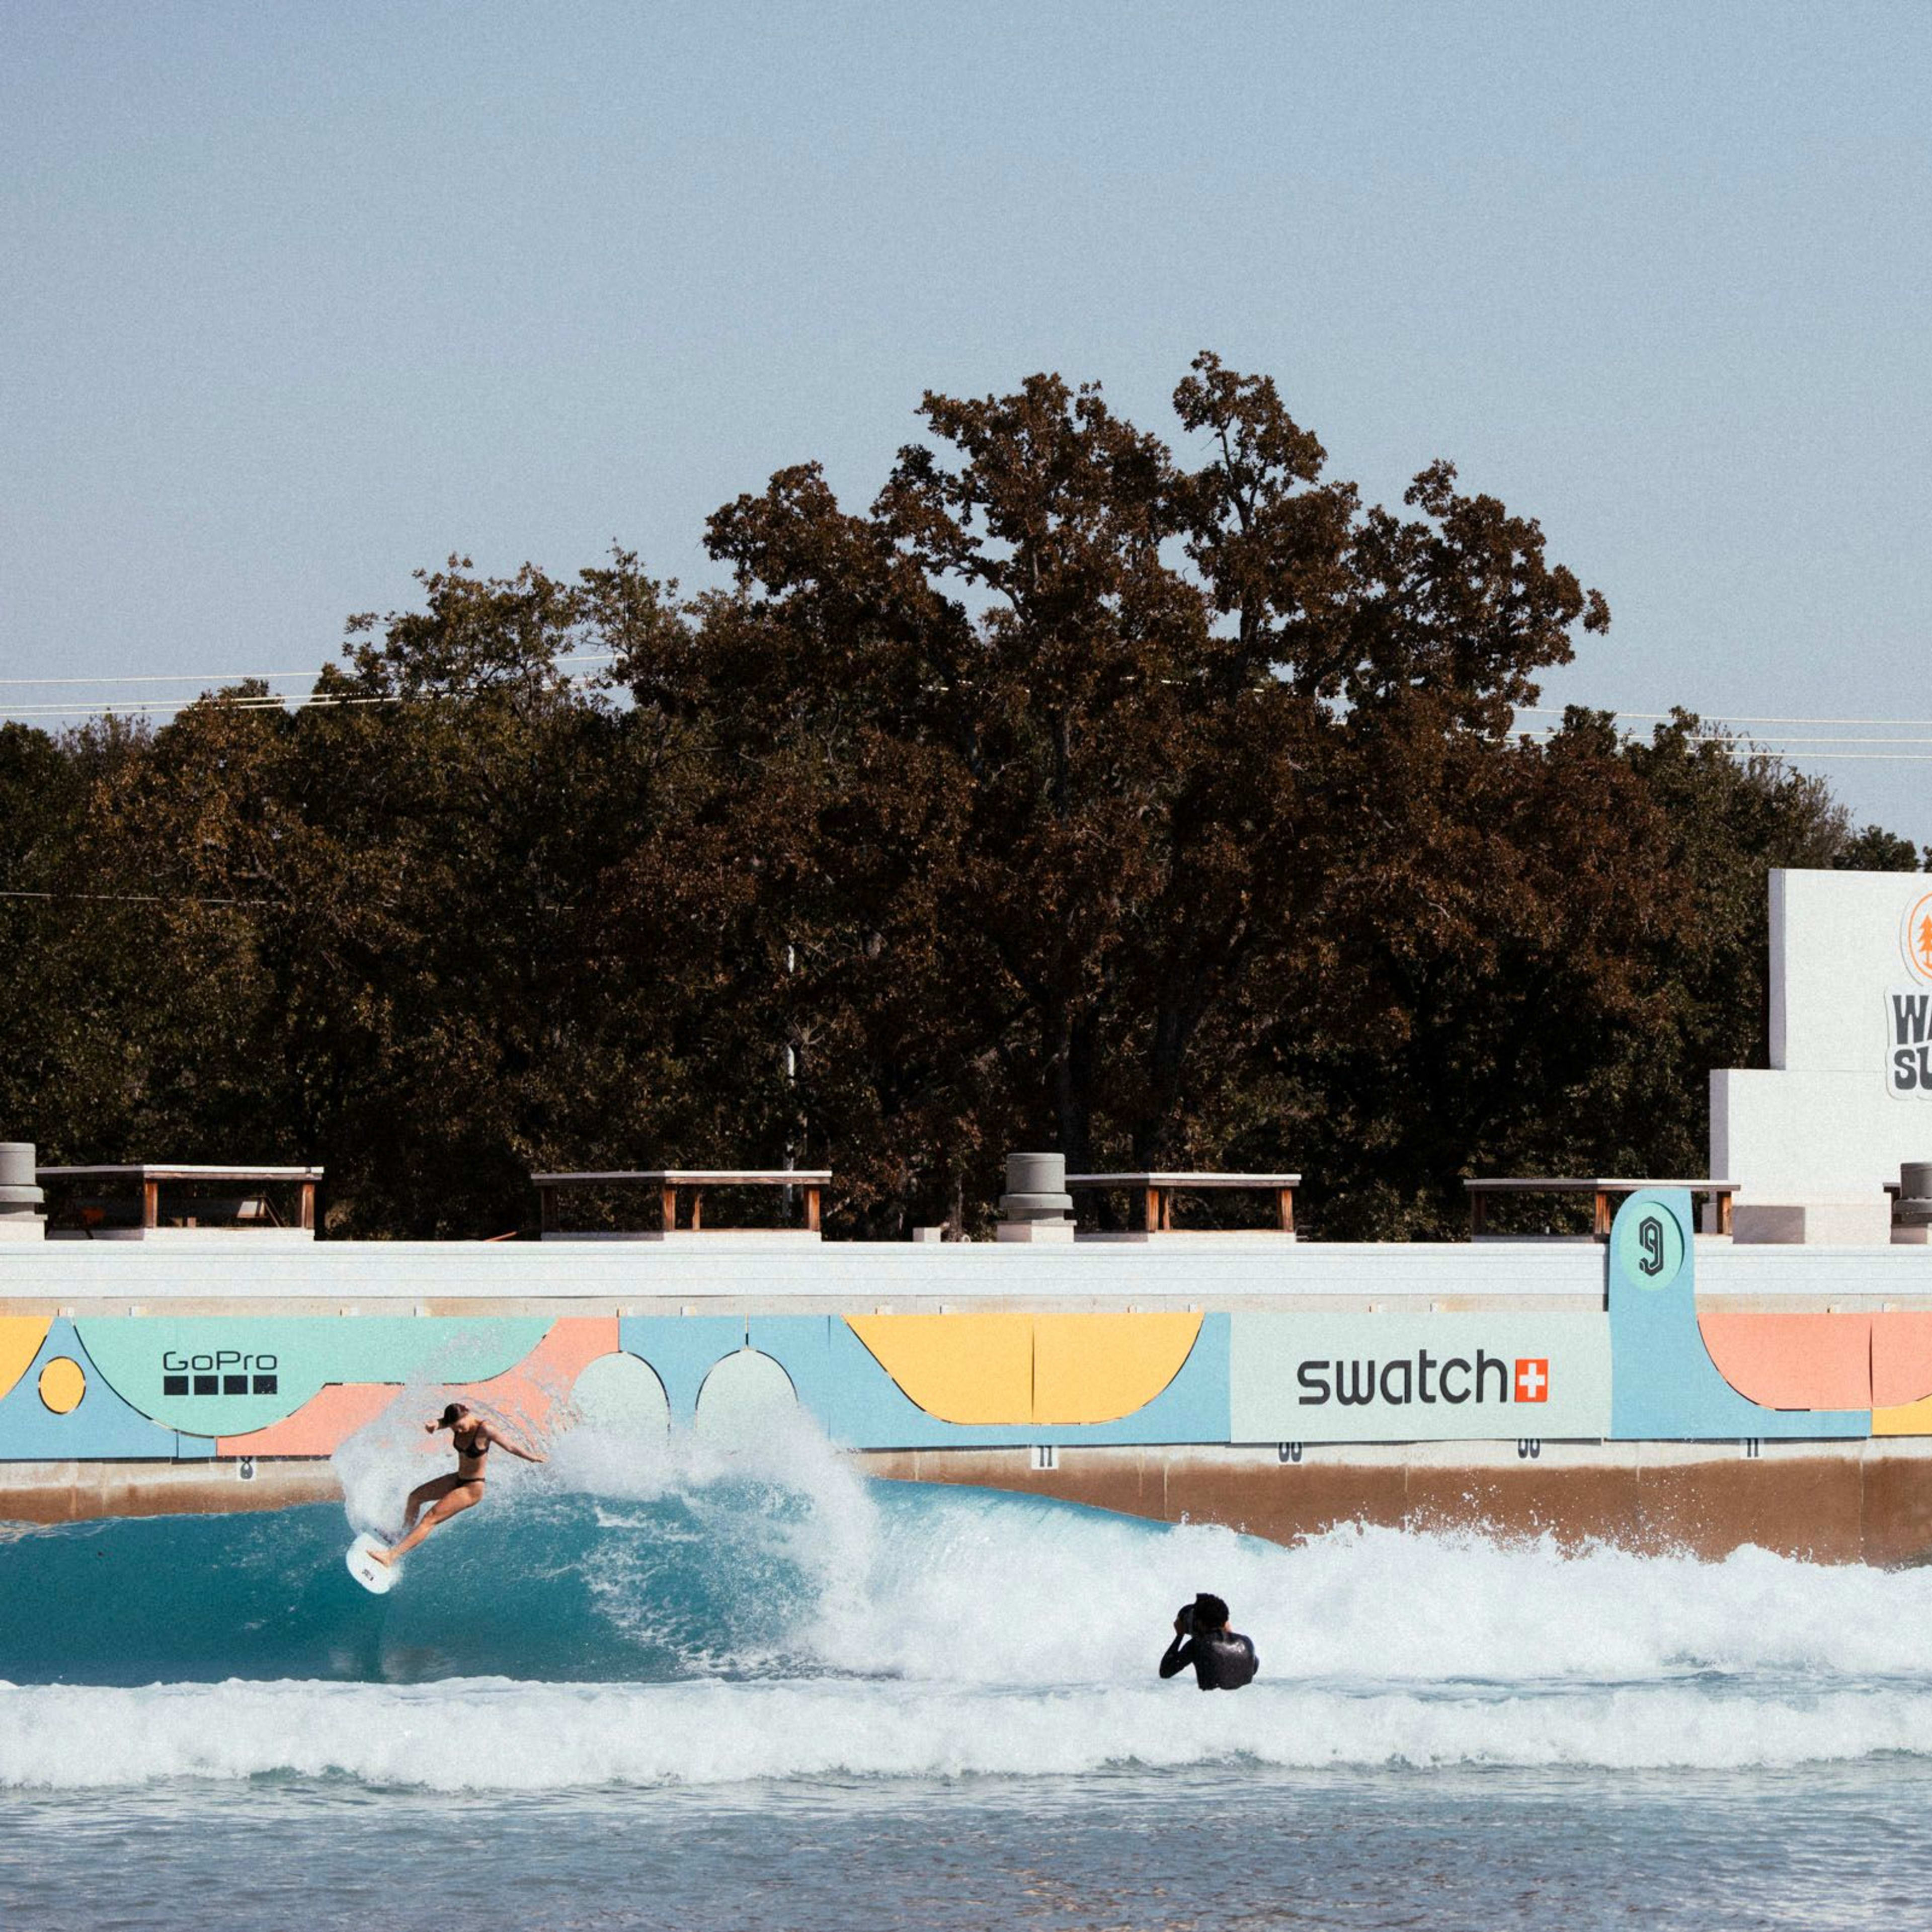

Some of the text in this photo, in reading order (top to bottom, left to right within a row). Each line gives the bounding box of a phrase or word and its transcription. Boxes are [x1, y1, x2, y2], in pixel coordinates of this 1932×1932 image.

[1892, 995, 1932, 1044] W
[1639, 1216, 1664, 1276] 9
[163, 1351, 277, 1371] GoPro
[1297, 1349, 1508, 1405] swatch
